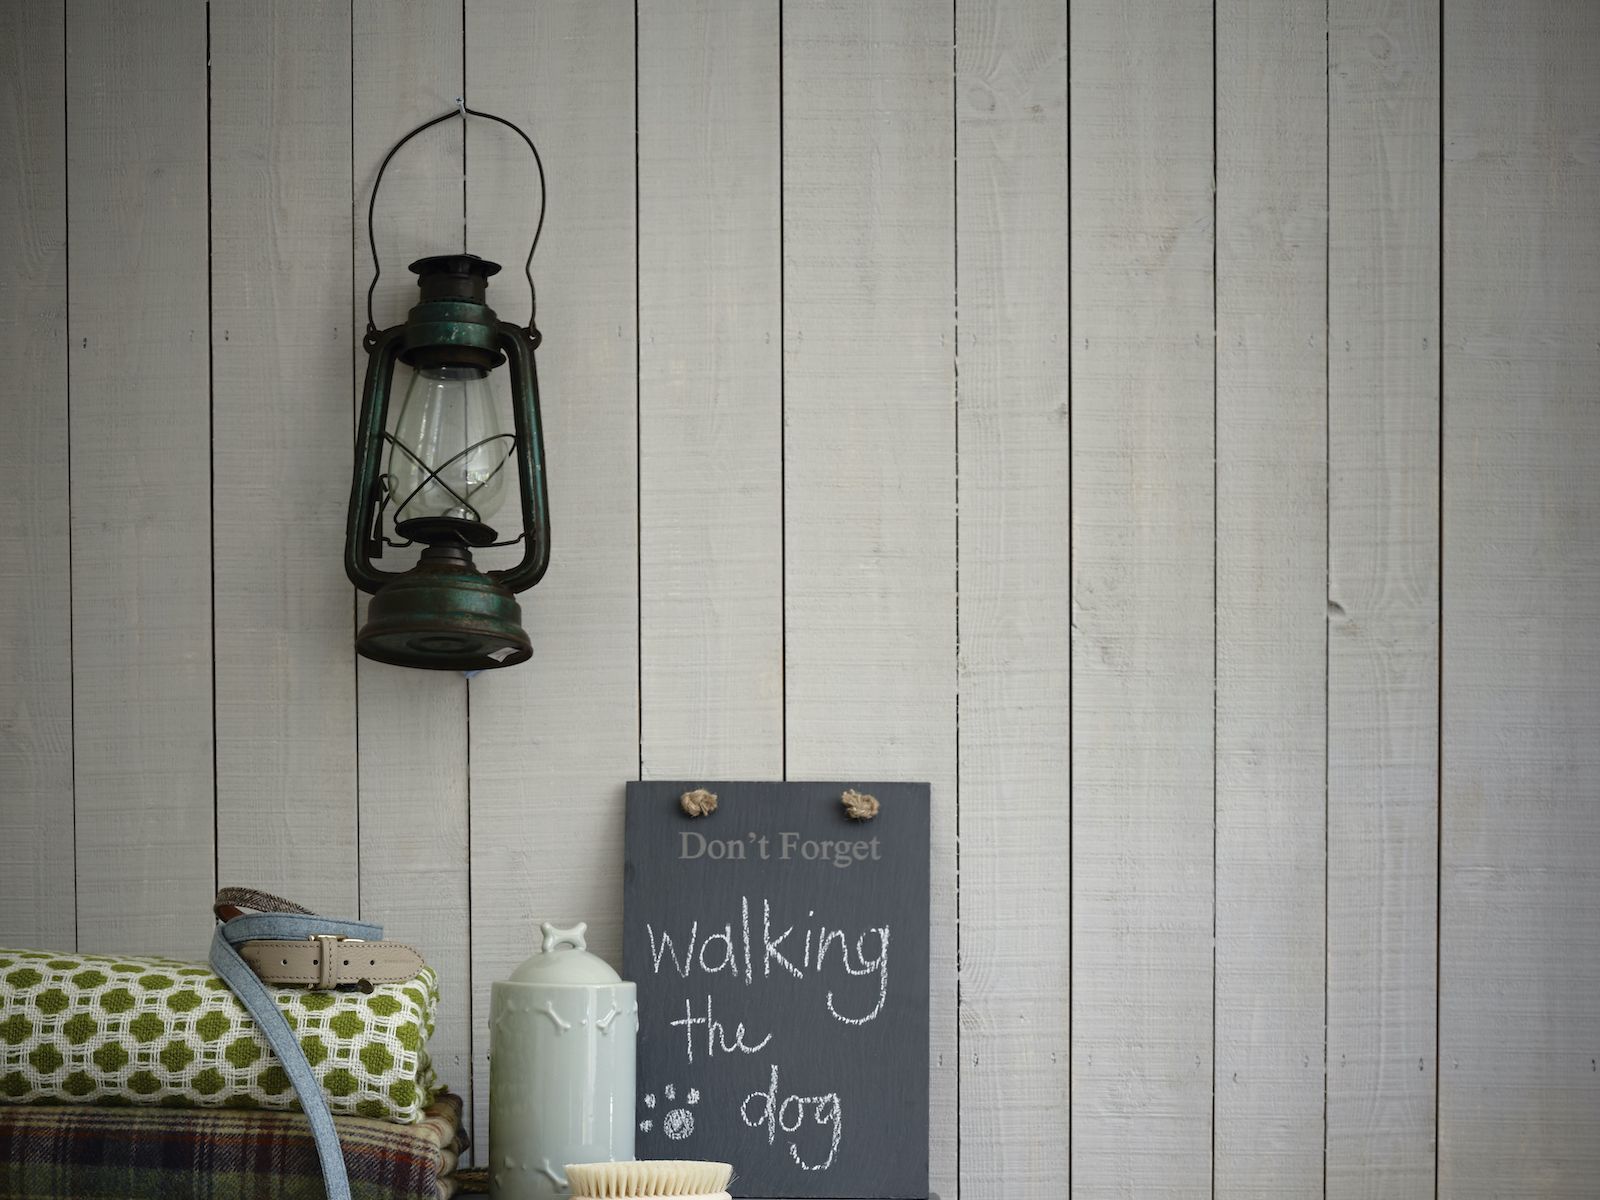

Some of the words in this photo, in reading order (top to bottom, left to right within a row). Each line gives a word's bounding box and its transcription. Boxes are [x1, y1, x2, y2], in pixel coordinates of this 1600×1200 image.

[779, 831, 882, 868] Forget
[670, 994, 773, 1064] the
[740, 1064, 841, 1171] dog
